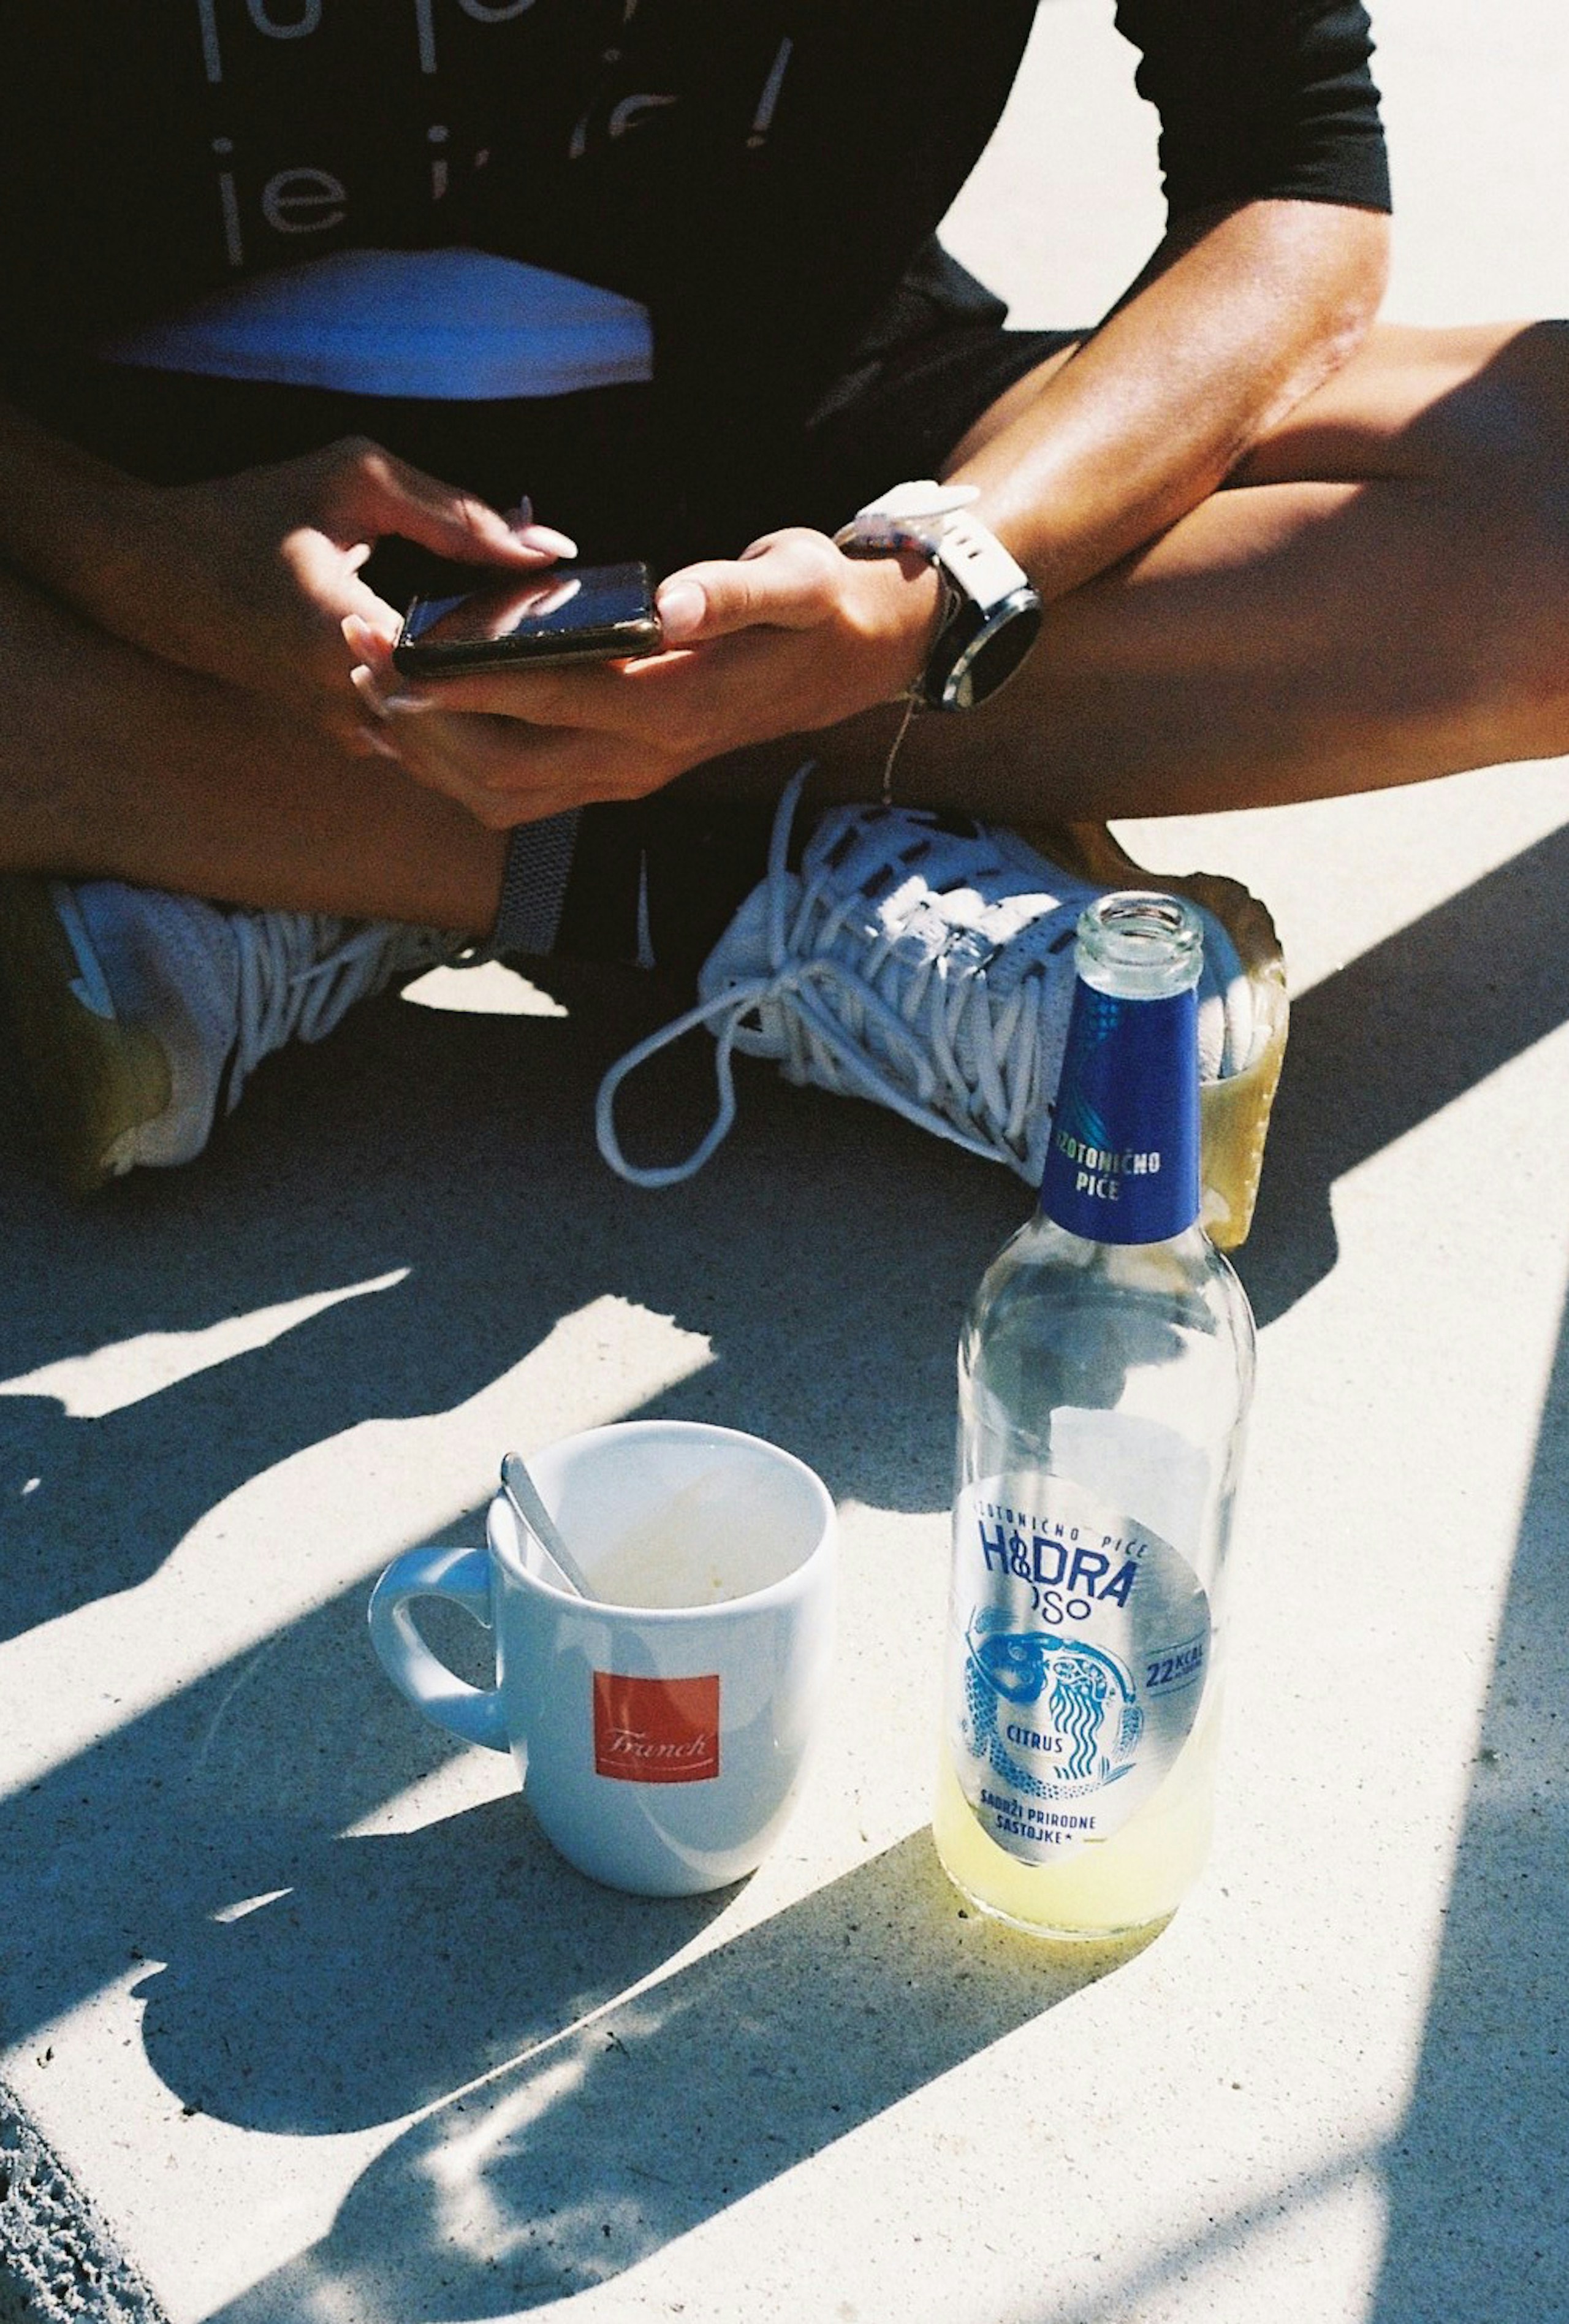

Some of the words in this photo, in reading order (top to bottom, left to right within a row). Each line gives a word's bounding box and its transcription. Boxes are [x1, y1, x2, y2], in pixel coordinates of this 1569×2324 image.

[211, 136, 348, 266] je
[607, 1728, 711, 1758] Franck
[1006, 1718, 1063, 1753] CITRUS
[981, 1788, 1024, 1821] SADRŽI
[1028, 1808, 1096, 1829] PRIRODNE
